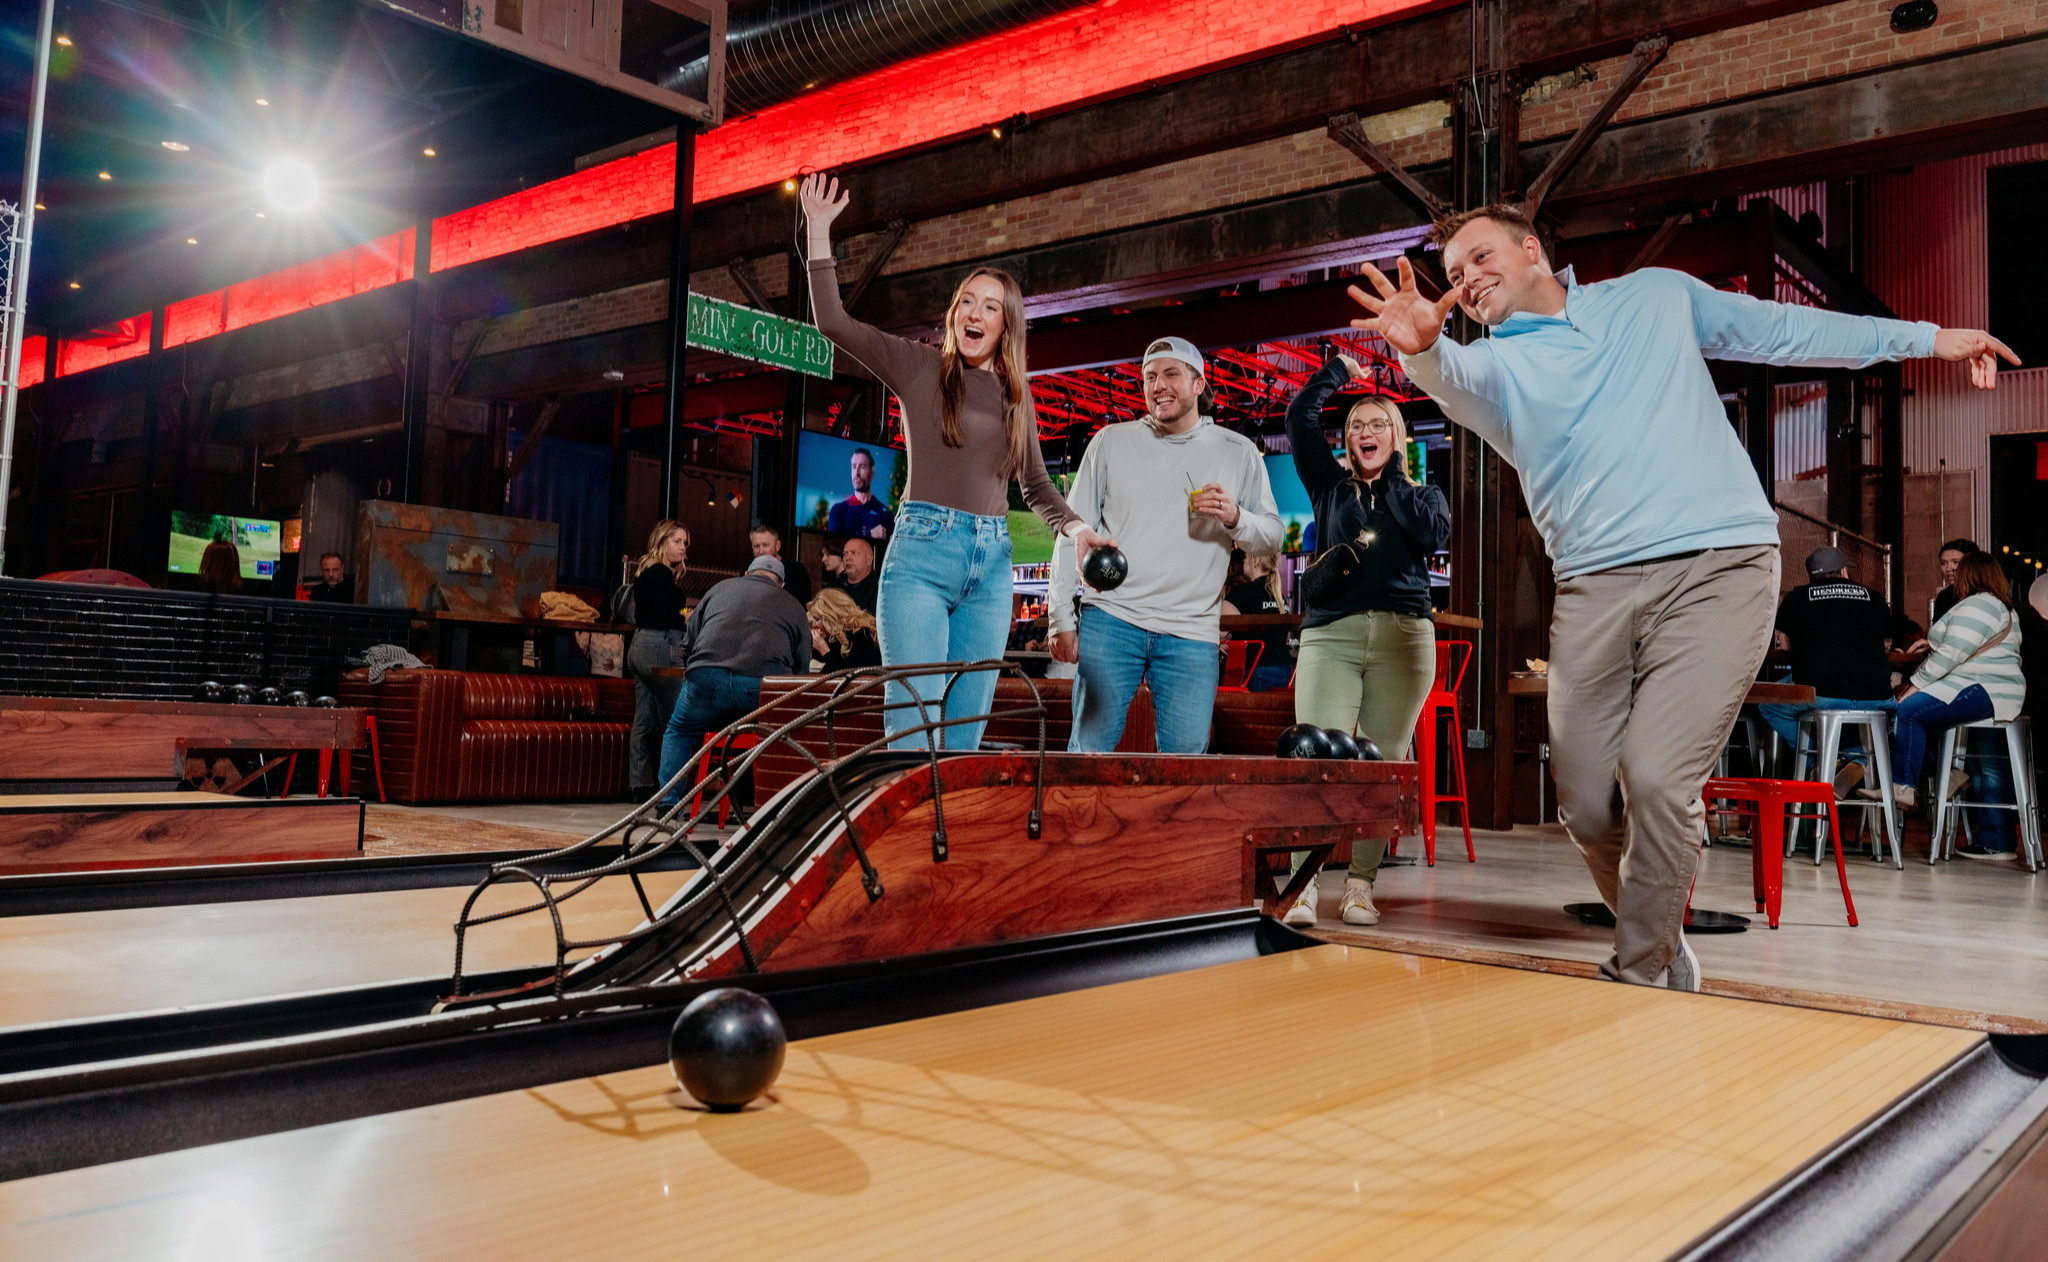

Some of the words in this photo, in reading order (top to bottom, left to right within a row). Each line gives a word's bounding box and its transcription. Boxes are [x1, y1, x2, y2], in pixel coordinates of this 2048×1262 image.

[752, 320, 801, 358] GOLF
[804, 332, 829, 366] RD
[1813, 587, 1865, 596] HENDRICKS
